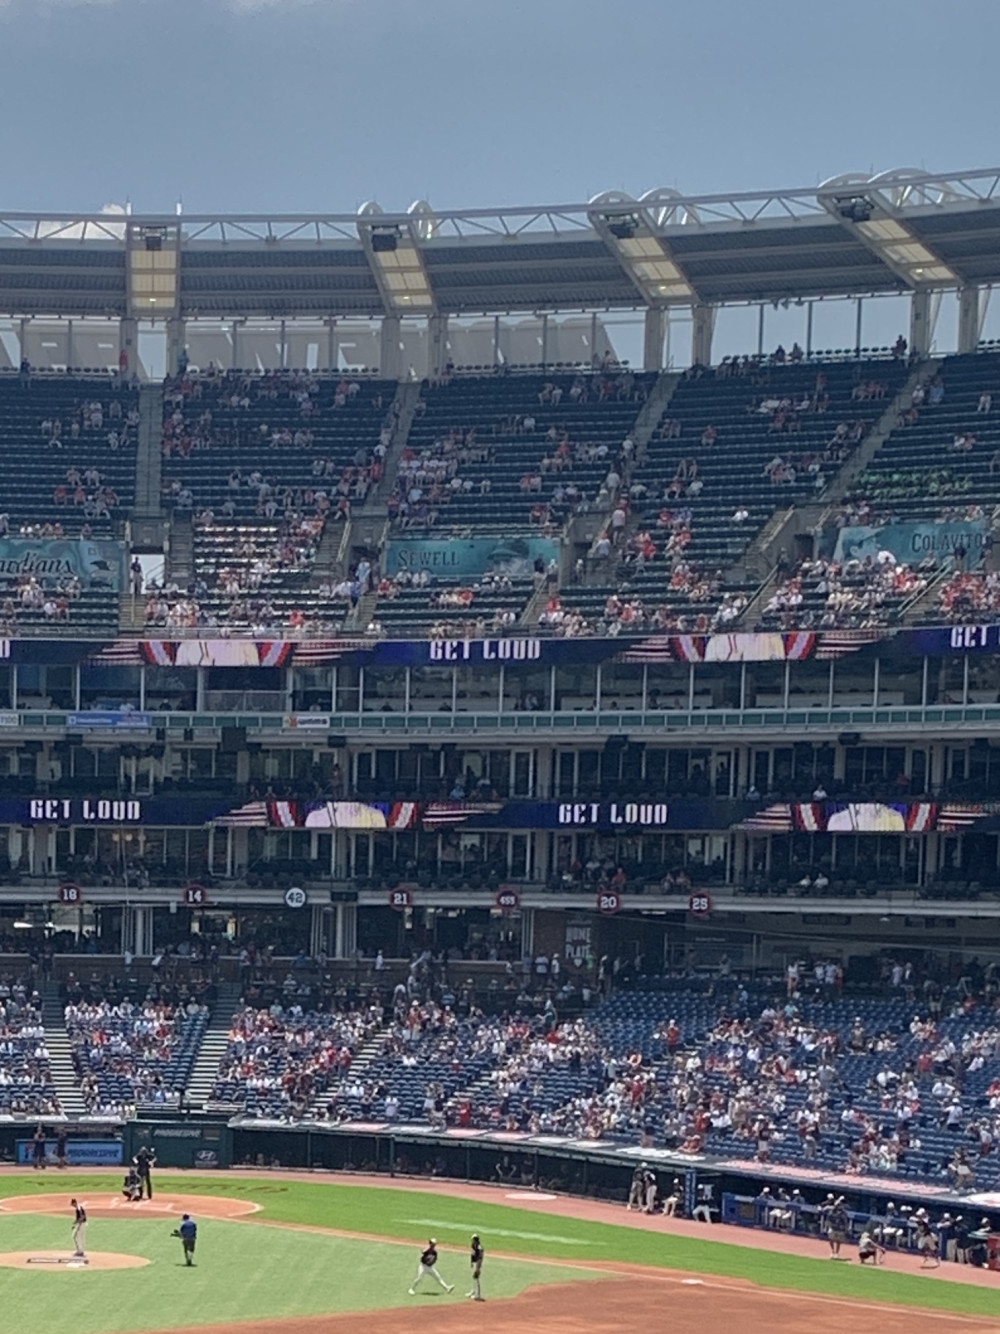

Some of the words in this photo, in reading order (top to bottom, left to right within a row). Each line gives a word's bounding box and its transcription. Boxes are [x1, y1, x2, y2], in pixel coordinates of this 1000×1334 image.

[911, 532, 982, 553] COLAVITO
[951, 626, 988, 648] GET
[429, 639, 471, 660] GET
[483, 639, 541, 660] LOUD
[30, 799, 71, 820] GET
[83, 799, 140, 821] LOUD
[558, 803, 599, 824] GET
[610, 803, 667, 824] LOUD
[63, 888, 78, 901] 18
[187, 890, 202, 902] 14
[287, 892, 303, 904] 42
[393, 892, 409, 905] 21
[600, 896, 617, 909] 20
[692, 897, 709, 910] 25
